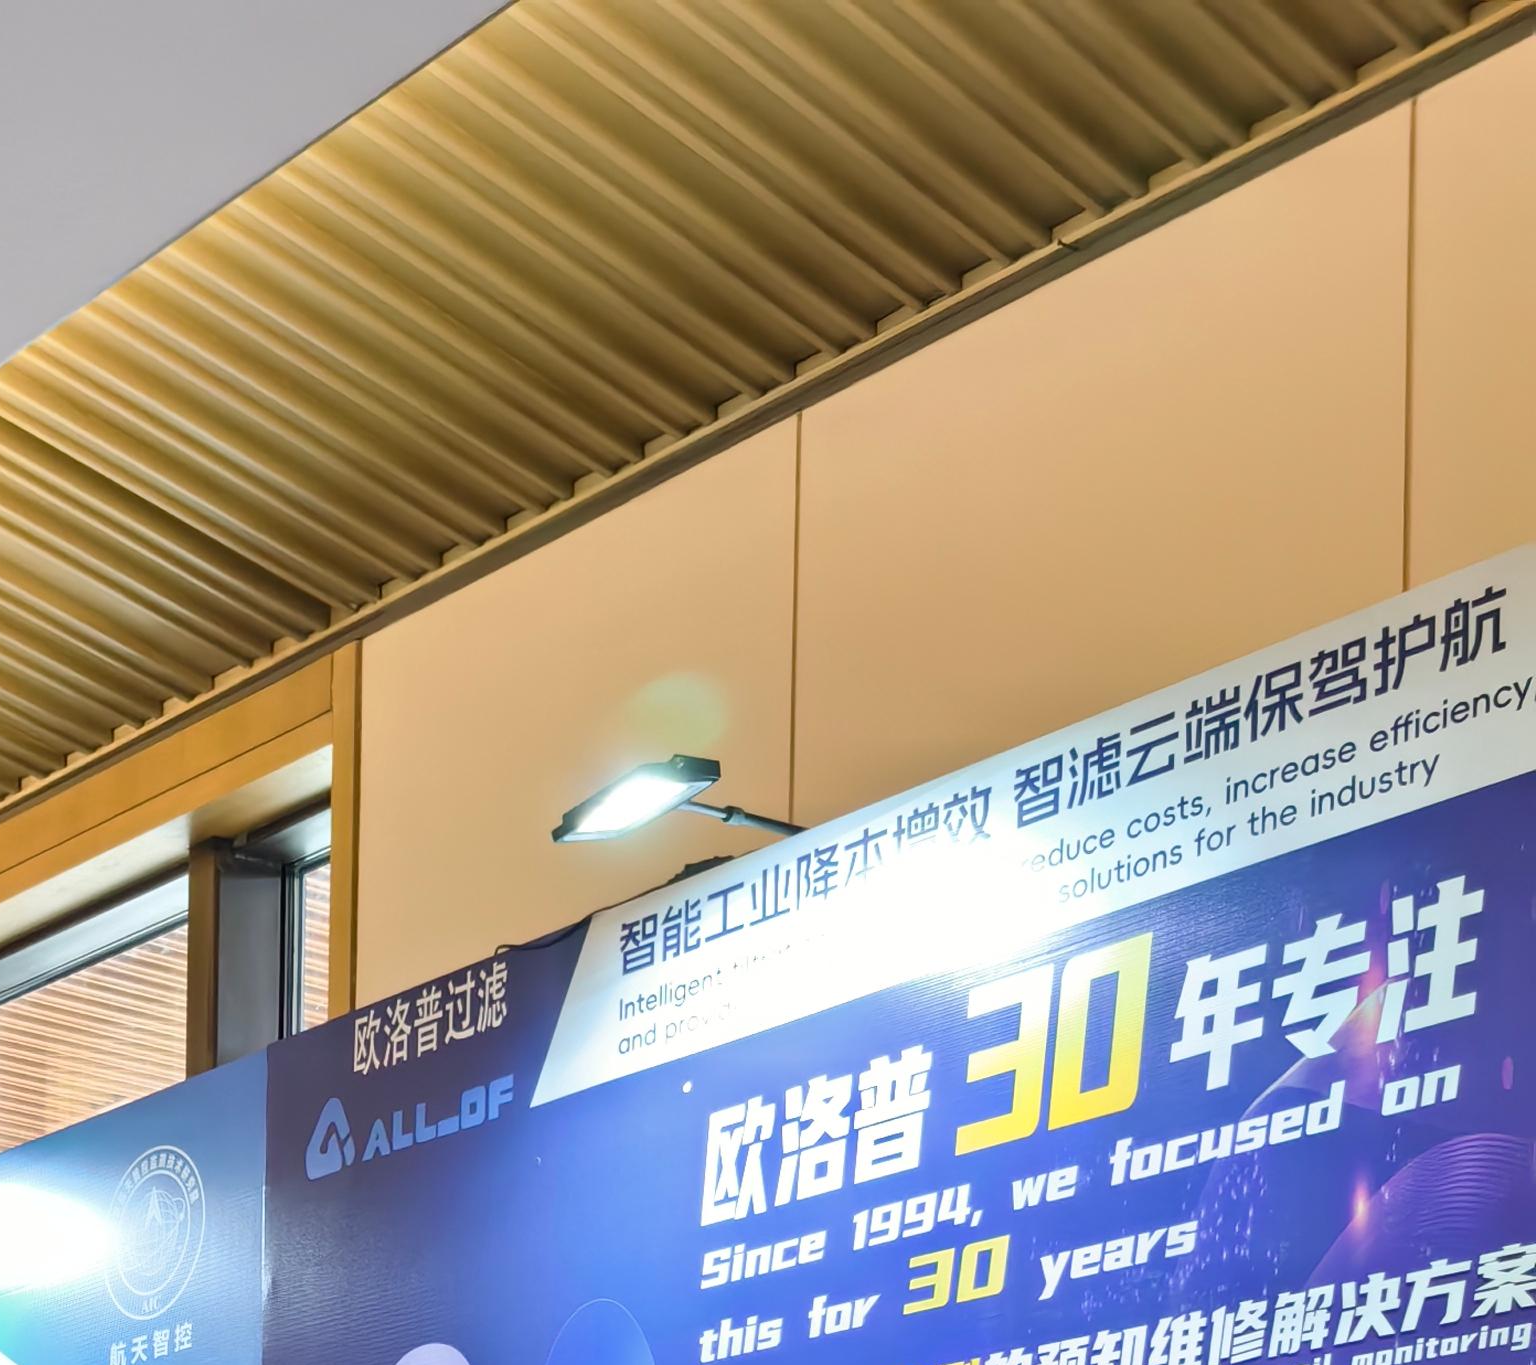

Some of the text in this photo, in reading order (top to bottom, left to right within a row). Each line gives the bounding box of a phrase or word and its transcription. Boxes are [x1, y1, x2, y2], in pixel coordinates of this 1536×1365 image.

[1014, 586, 1507, 829] 智滤云端保驾护航
[1126, 792, 1212, 838] costs,
[1225, 742, 1356, 805] increase
[618, 1023, 657, 1056] and
[1058, 845, 1183, 904] solutions
[1195, 822, 1237, 858] for
[1248, 804, 1296, 839] the
[1310, 753, 1441, 817] industry
[353, 962, 508, 1075] 欧洛普过滤
[700, 1063, 1461, 1290] Since 1994, we focused on
[698, 1220, 1198, 1364] this for 30 years
